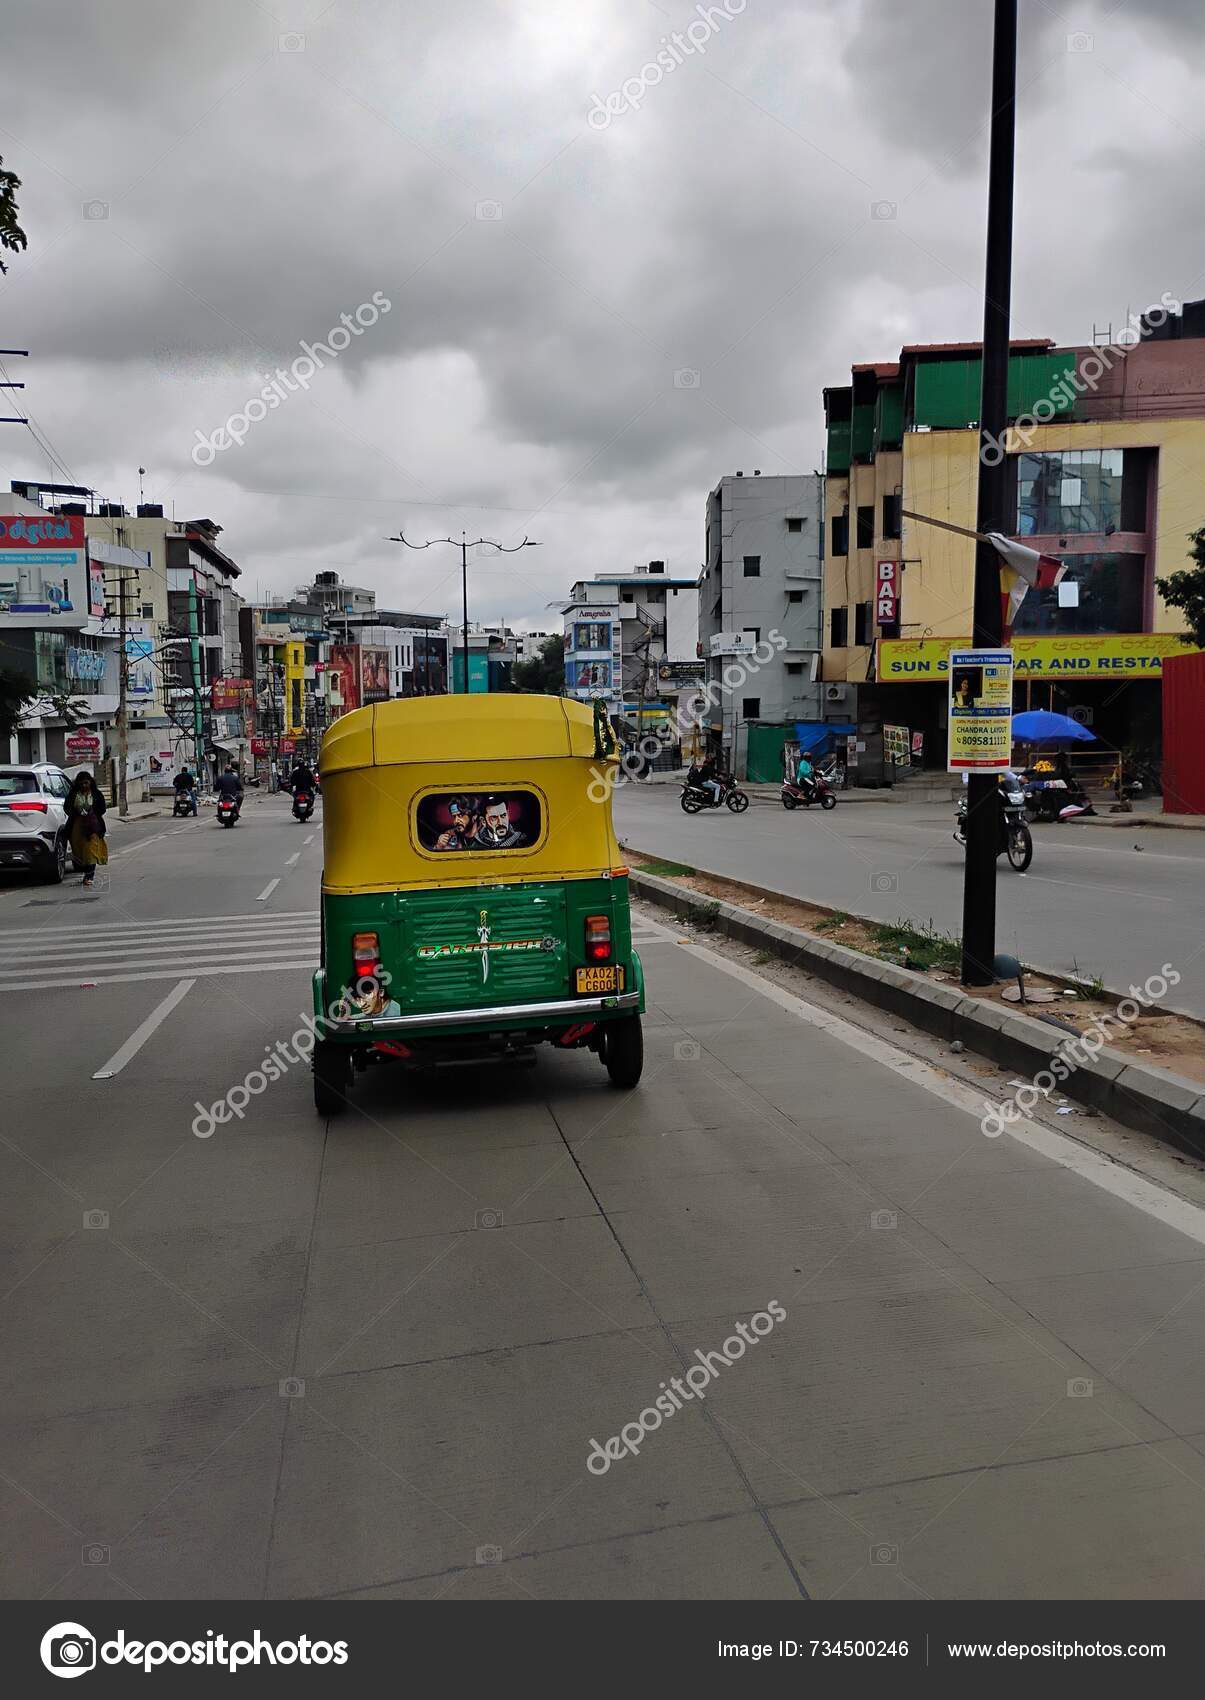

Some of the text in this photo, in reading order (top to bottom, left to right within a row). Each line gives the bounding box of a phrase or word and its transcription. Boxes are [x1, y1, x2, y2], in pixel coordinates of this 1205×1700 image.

[9, 520, 73, 544] digital
[878, 563, 895, 617] BAR
[579, 610, 612, 619] Anugraha
[891, 660, 930, 672] SUN
[1012, 657, 1043, 670] AR
[1048, 657, 1091, 669] AND
[1097, 656, 1162, 669] RESTA
[956, 726, 989, 734] CHANDRA
[962, 736, 1007, 745] 8095811112
